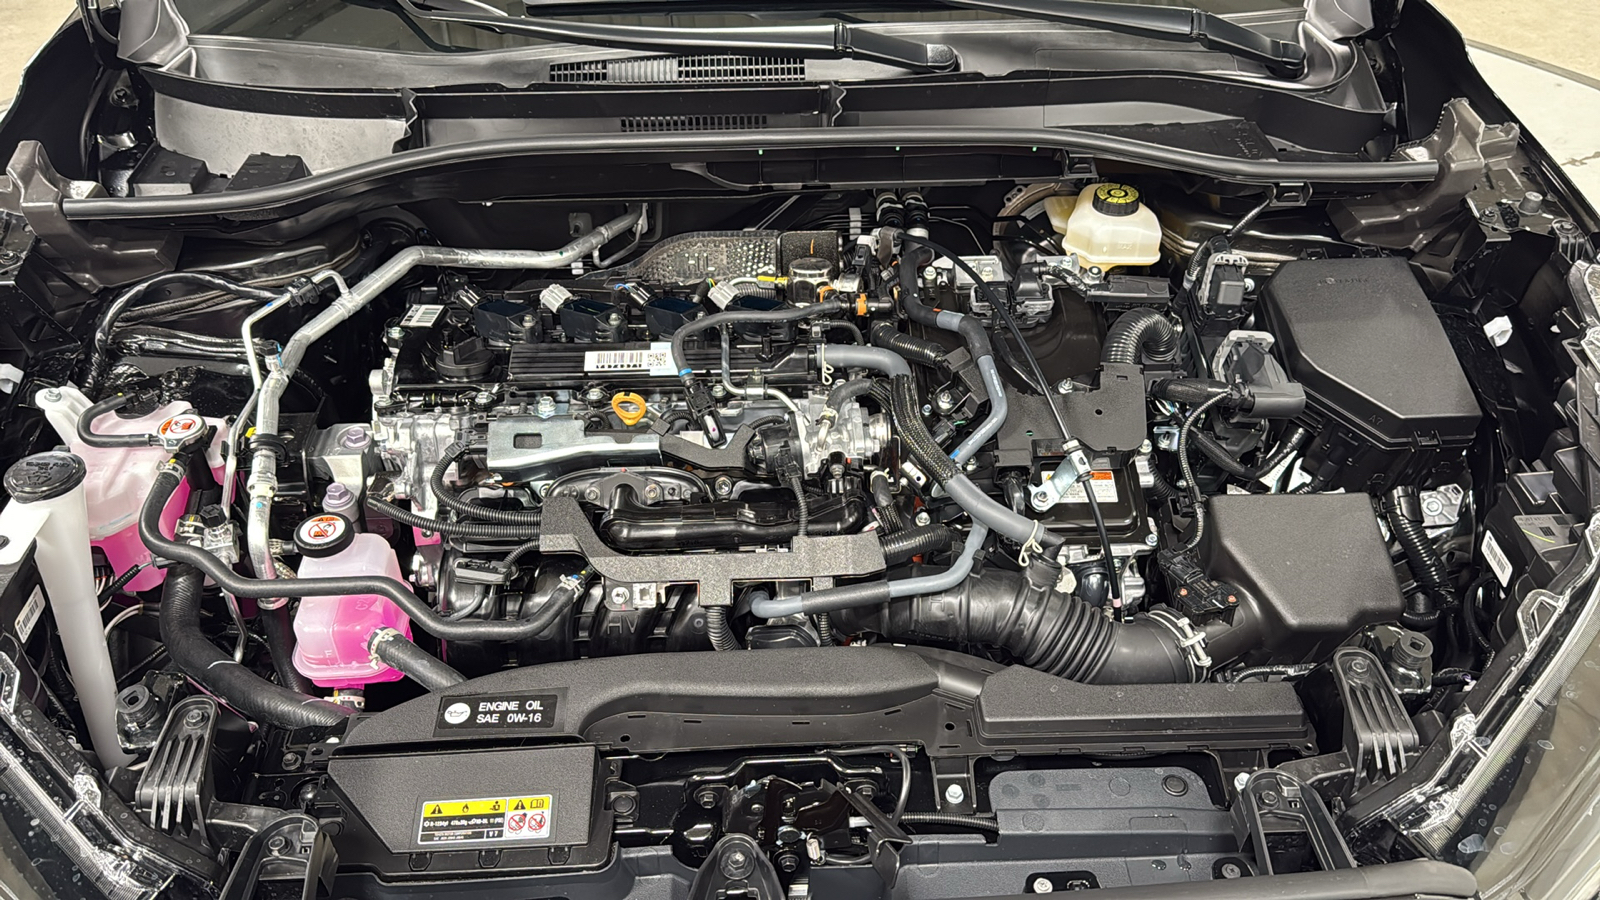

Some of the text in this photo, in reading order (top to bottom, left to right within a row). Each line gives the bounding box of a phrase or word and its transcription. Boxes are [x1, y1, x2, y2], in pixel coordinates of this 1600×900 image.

[1368, 414, 1384, 426] A7
[607, 614, 640, 635] HV
[478, 700, 544, 712] ENGINE OIL
[476, 712, 542, 724] SAE 0W-16
